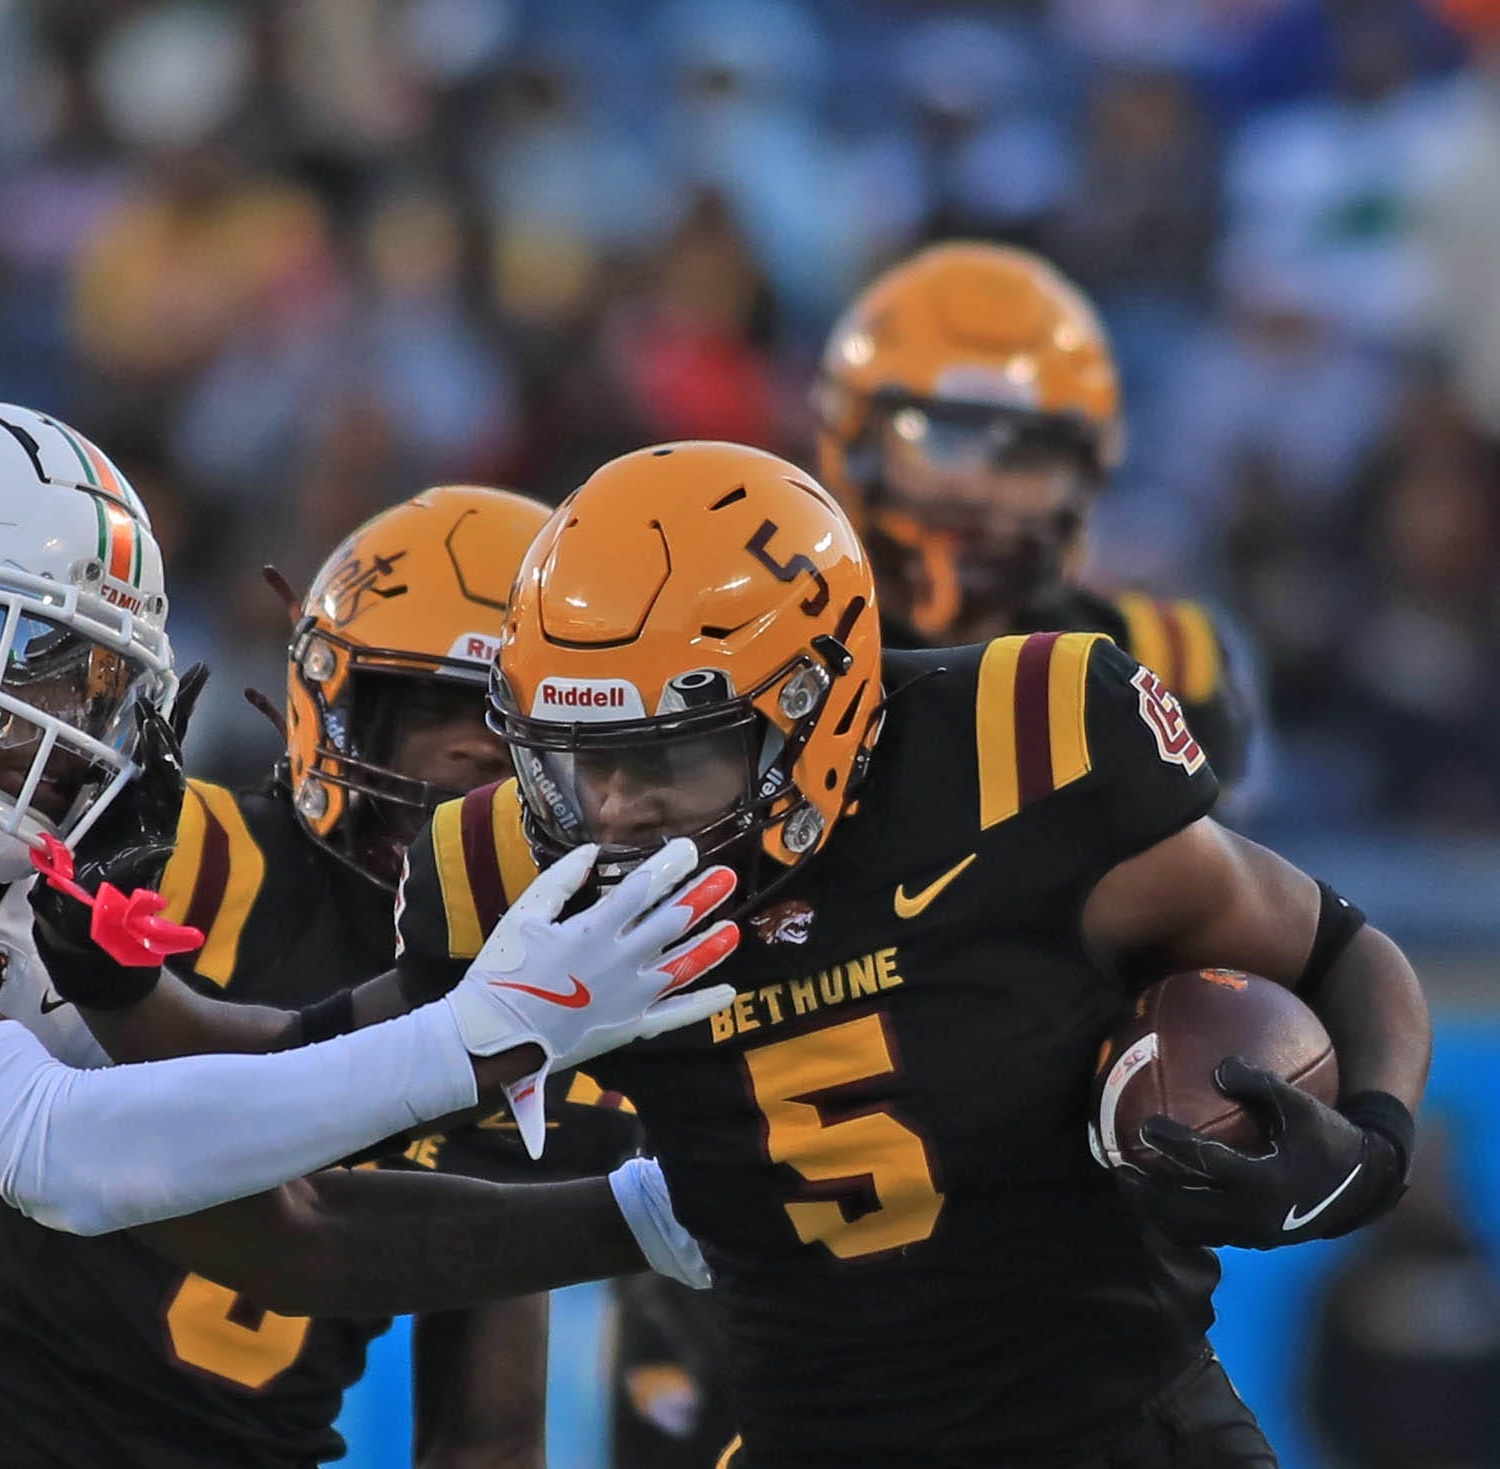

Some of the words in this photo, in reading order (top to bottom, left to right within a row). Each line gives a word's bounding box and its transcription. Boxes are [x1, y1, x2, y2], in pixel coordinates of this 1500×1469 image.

[746, 518, 828, 617] 5
[542, 684, 624, 707] Riddell
[529, 757, 578, 831] Riddell
[710, 946, 904, 1044] BETHUNE
[743, 1012, 946, 1261] 5
